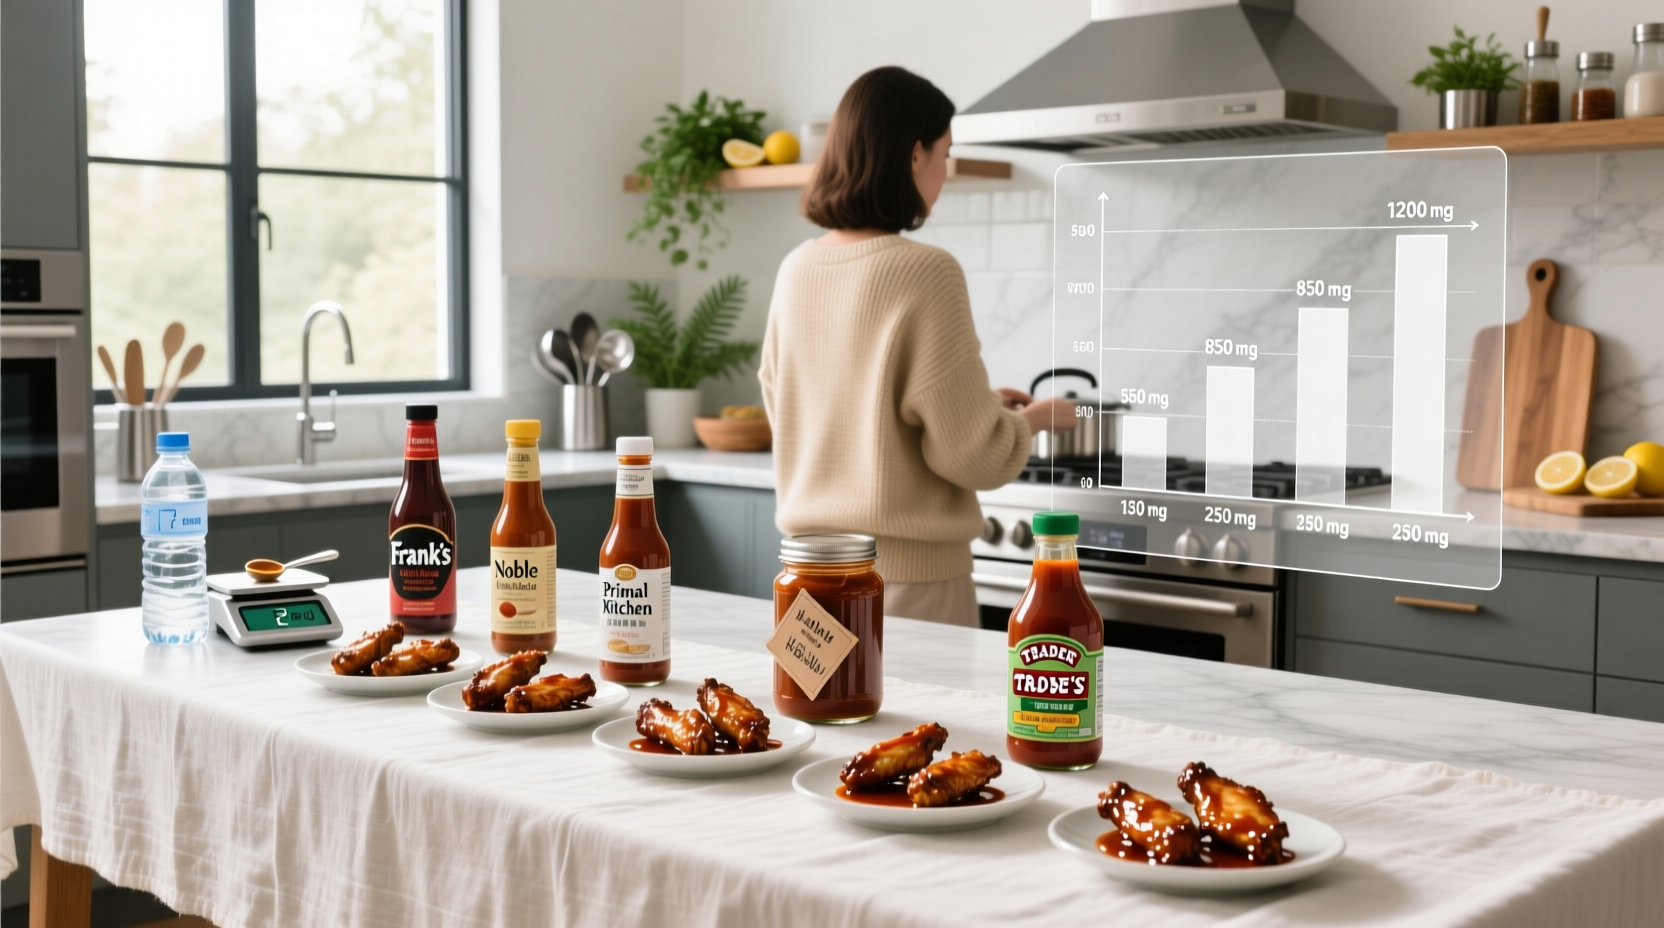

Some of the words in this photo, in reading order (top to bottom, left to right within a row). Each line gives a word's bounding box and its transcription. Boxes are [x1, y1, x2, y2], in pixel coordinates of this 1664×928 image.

[1387, 201, 1427, 218] 1200
[1430, 205, 1453, 222] mg
[1296, 280, 1324, 296] 850
[1328, 284, 1351, 302] mg
[1205, 339, 1233, 355] 850
[1236, 343, 1258, 360] mg
[1149, 392, 1169, 409] mg
[1148, 505, 1167, 522] mg
[1205, 506, 1231, 524] 250
[1235, 513, 1256, 530] mg
[1296, 514, 1323, 532] 250
[1327, 520, 1349, 539] mg
[1392, 523, 1421, 542] 250
[1425, 530, 1449, 549] mg
[391, 541, 451, 566] Frank's
[495, 559, 538, 578] Noble
[603, 582, 648, 598] Primal
